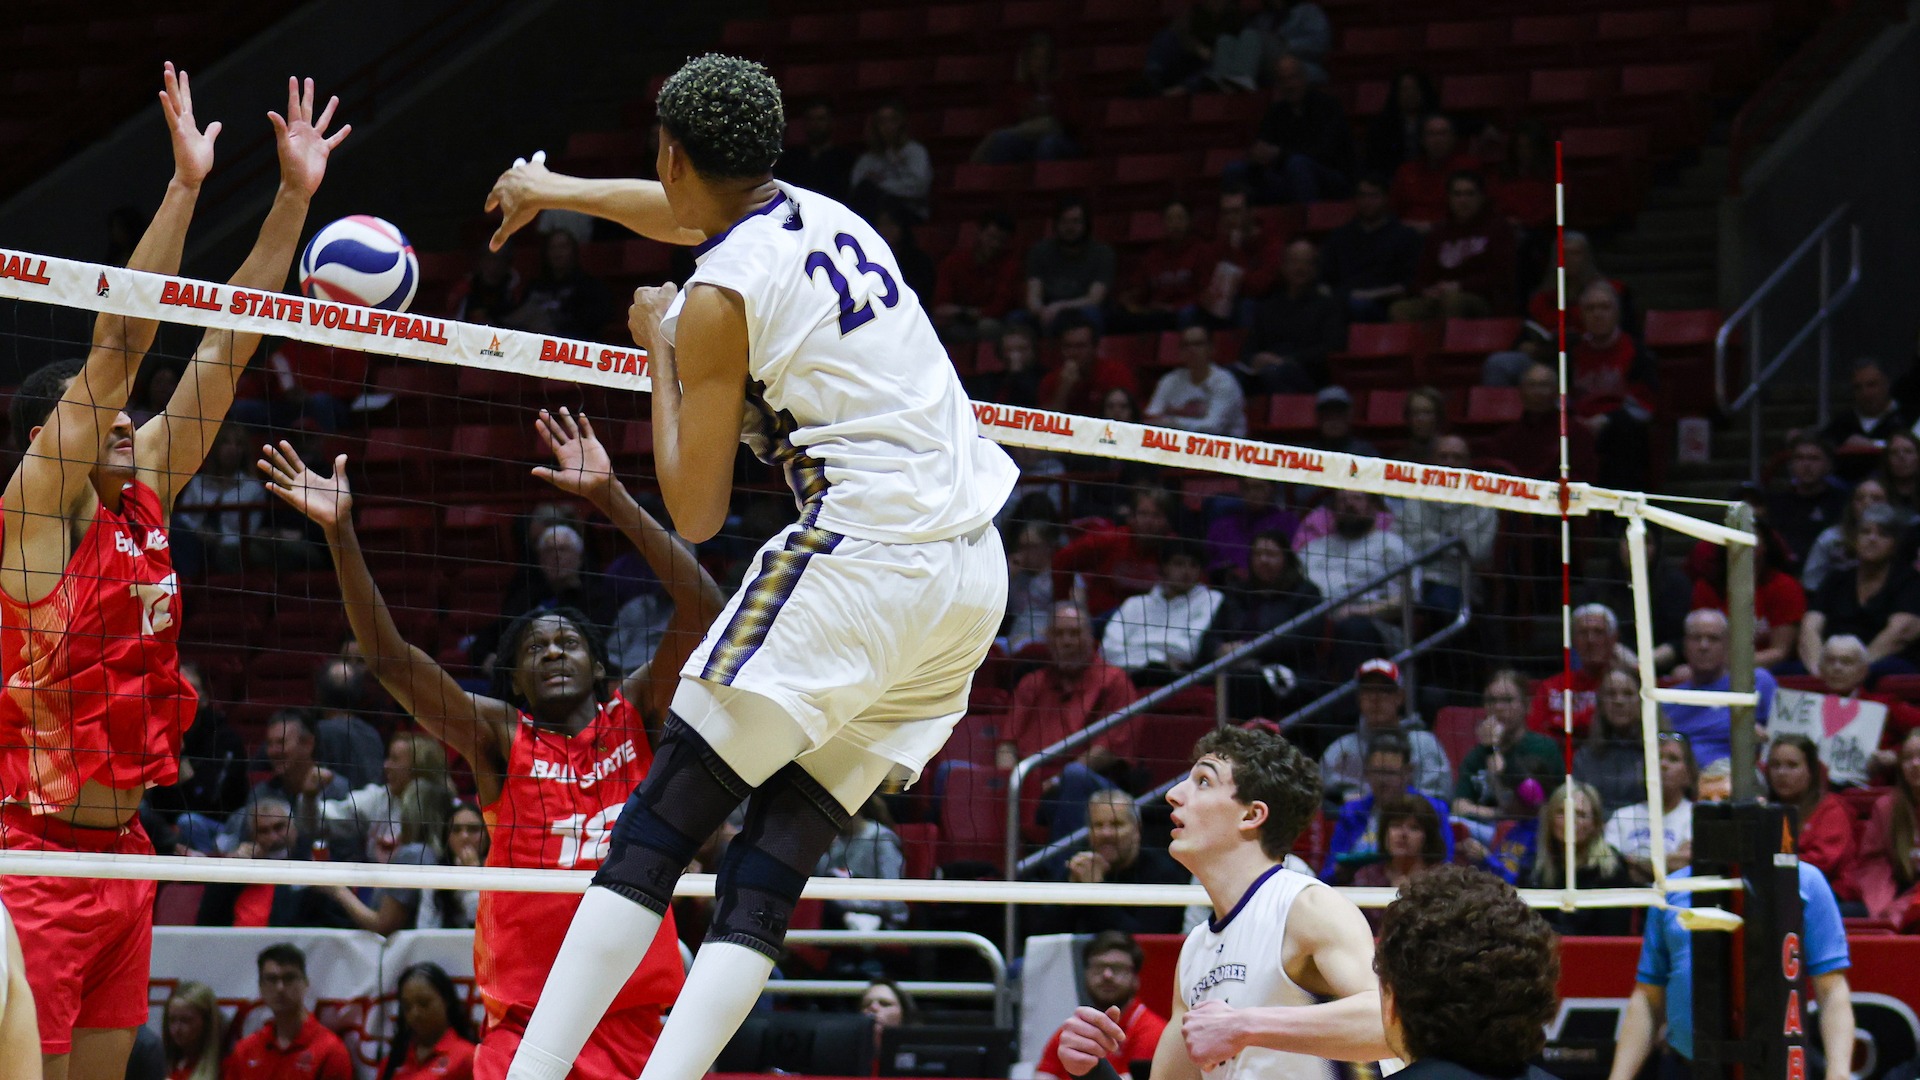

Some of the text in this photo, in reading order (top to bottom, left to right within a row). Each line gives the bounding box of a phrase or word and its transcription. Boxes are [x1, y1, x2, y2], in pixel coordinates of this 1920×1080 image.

[804, 230, 900, 339] 23
[159, 280, 448, 345] BALL STATE VOLLEYBALL
[539, 338, 652, 377] BALL STAT
[971, 403, 1074, 437] VOLLEYBALL
[1141, 429, 1325, 473] BALL STATE VOLLEYBALL
[1384, 463, 1417, 484] BALL
[1775, 691, 1816, 723] WE
[529, 739, 638, 790] BALL STATE
